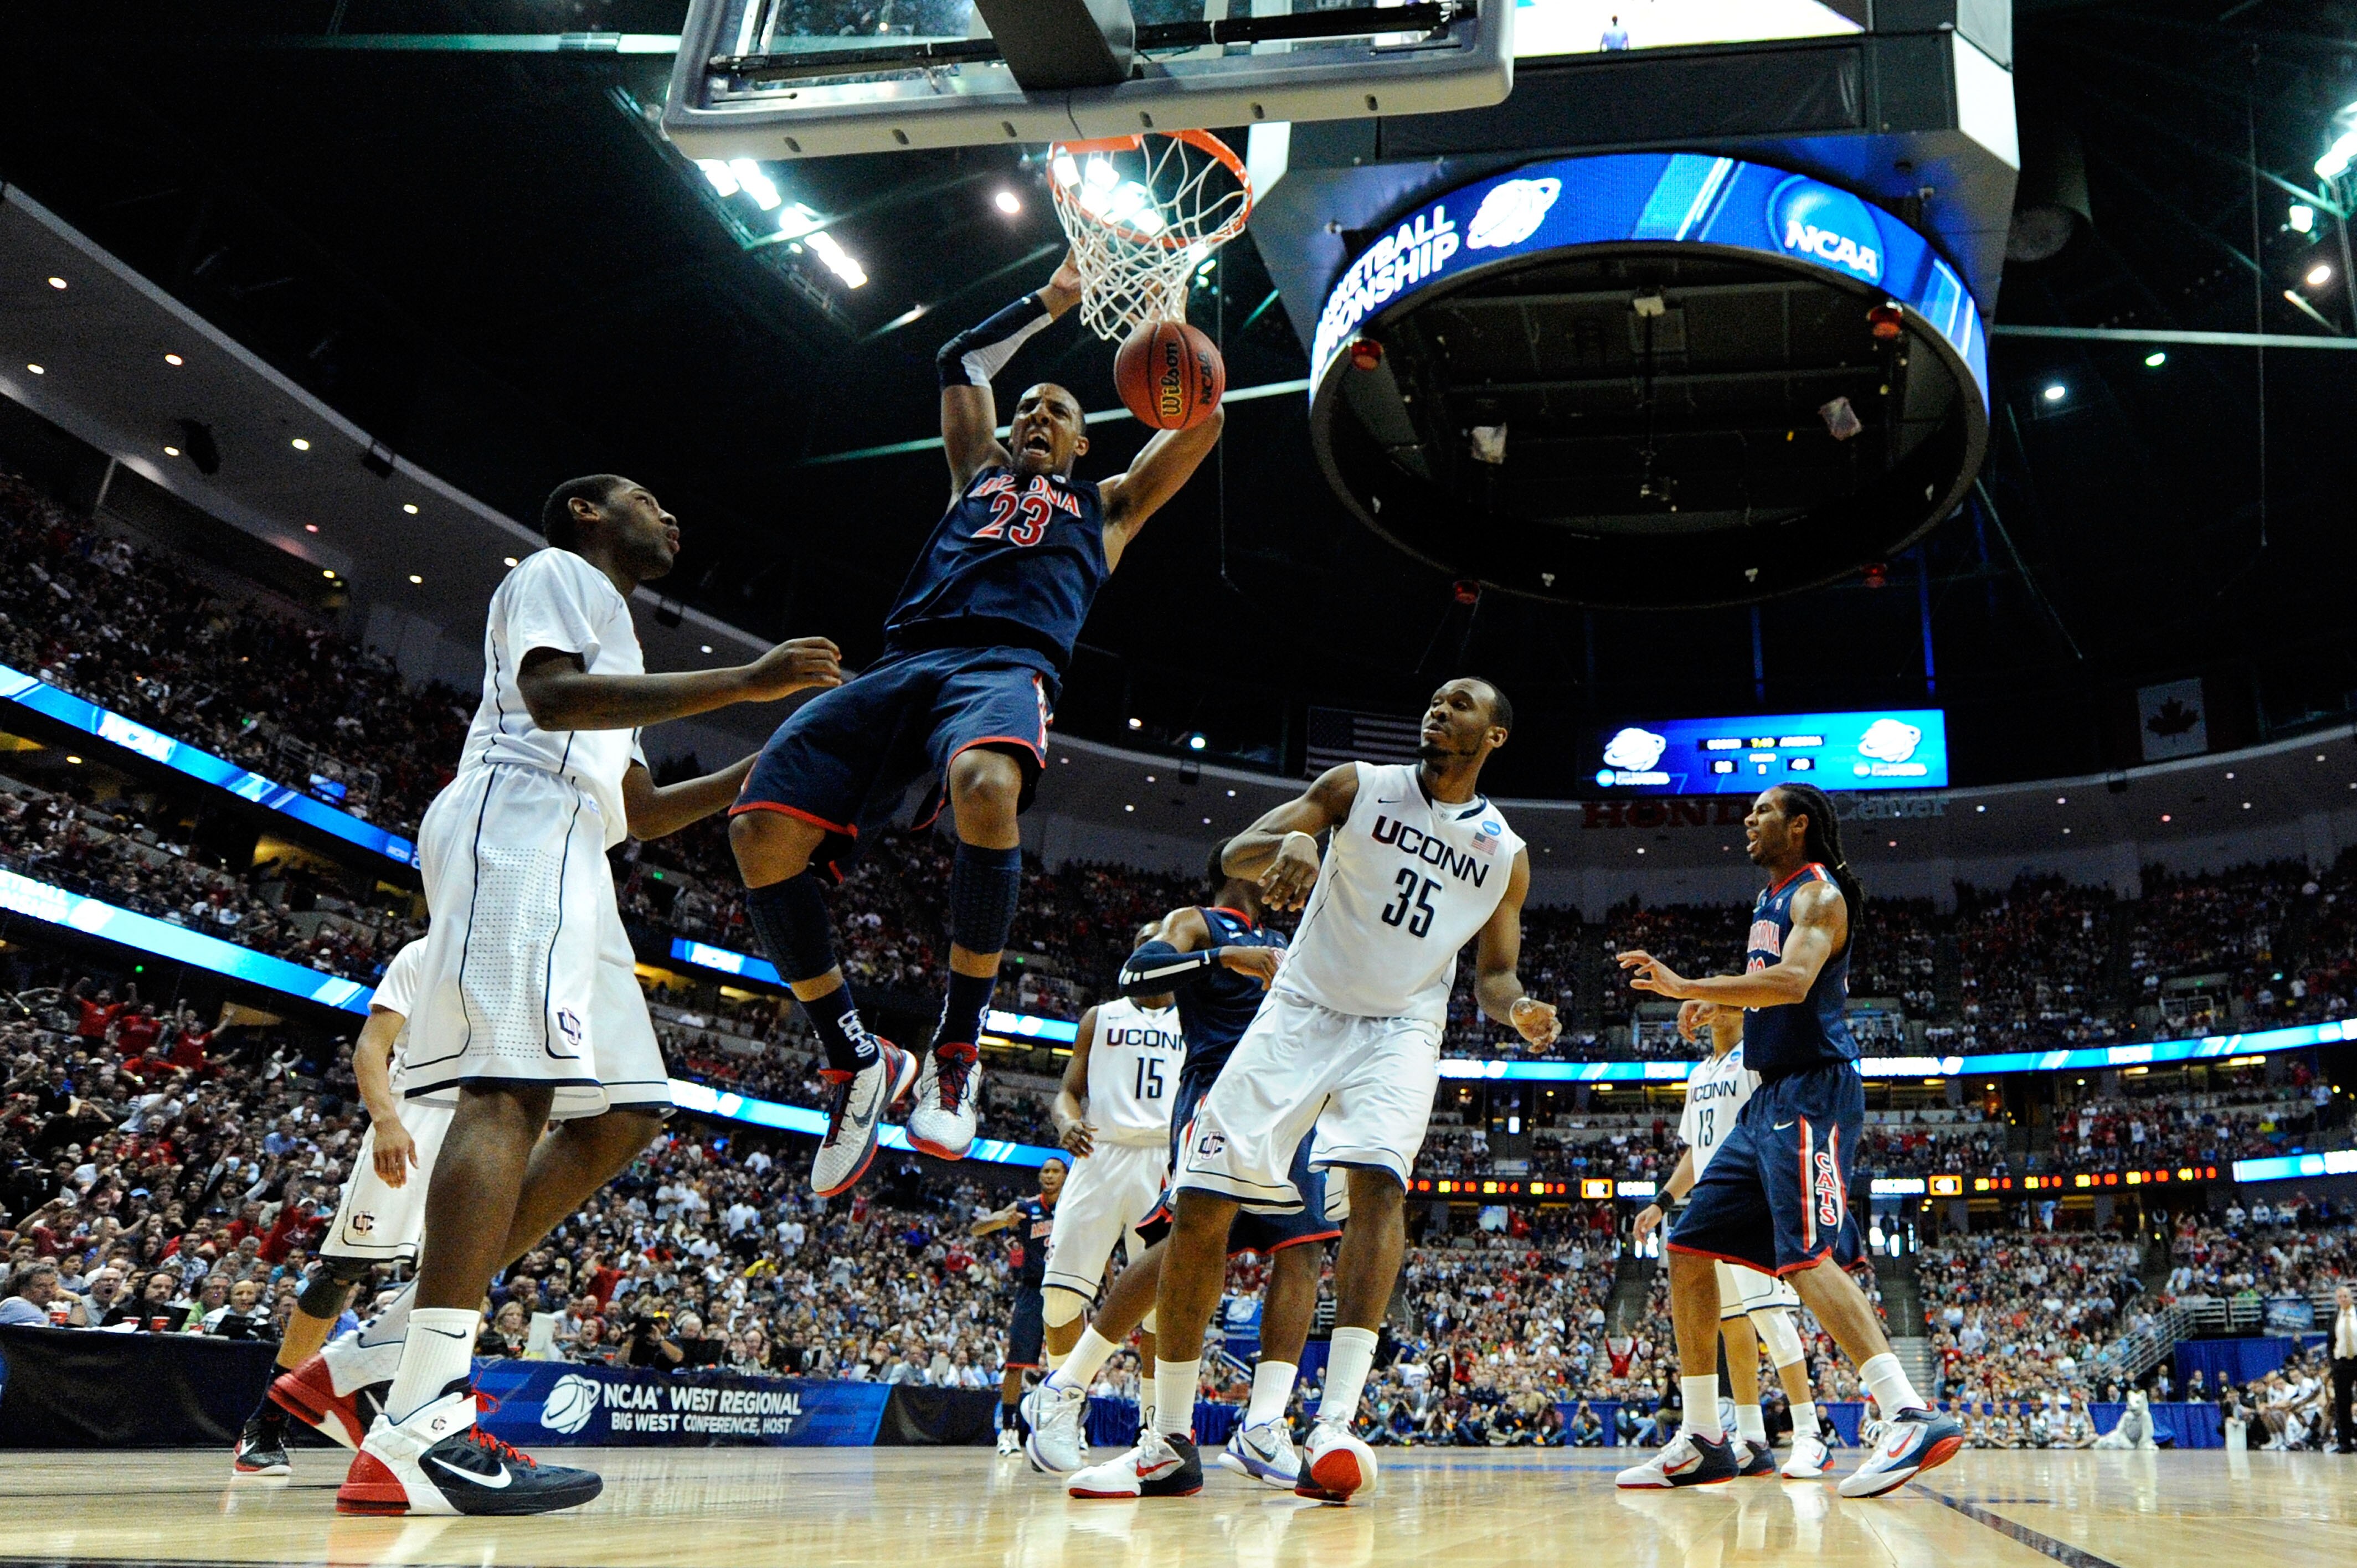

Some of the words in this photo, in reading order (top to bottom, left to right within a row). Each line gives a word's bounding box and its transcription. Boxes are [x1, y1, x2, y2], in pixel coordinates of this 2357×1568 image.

[1784, 220, 1879, 277] NCAA
[1161, 341, 1182, 417] Wilson
[1198, 350, 1213, 405] NCAA
[966, 474, 1082, 518] ARONA
[970, 491, 1051, 547] 23
[1582, 801, 1752, 829] HOND
[1371, 814, 1490, 888] UCONN
[1381, 868, 1443, 938] 35
[1135, 1056, 1165, 1099] 15
[1690, 1080, 1737, 1105] UCONN
[1697, 1107, 1714, 1148] 13
[1814, 1152, 1838, 1226] CATS
[611, 1412, 633, 1431] BIG
[635, 1414, 681, 1432] WEST
[682, 1414, 760, 1437] CONFERENCE,
[762, 1417, 793, 1434] HOST
[670, 1386, 719, 1411] WEST
[719, 1390, 802, 1416] REGIONAL
